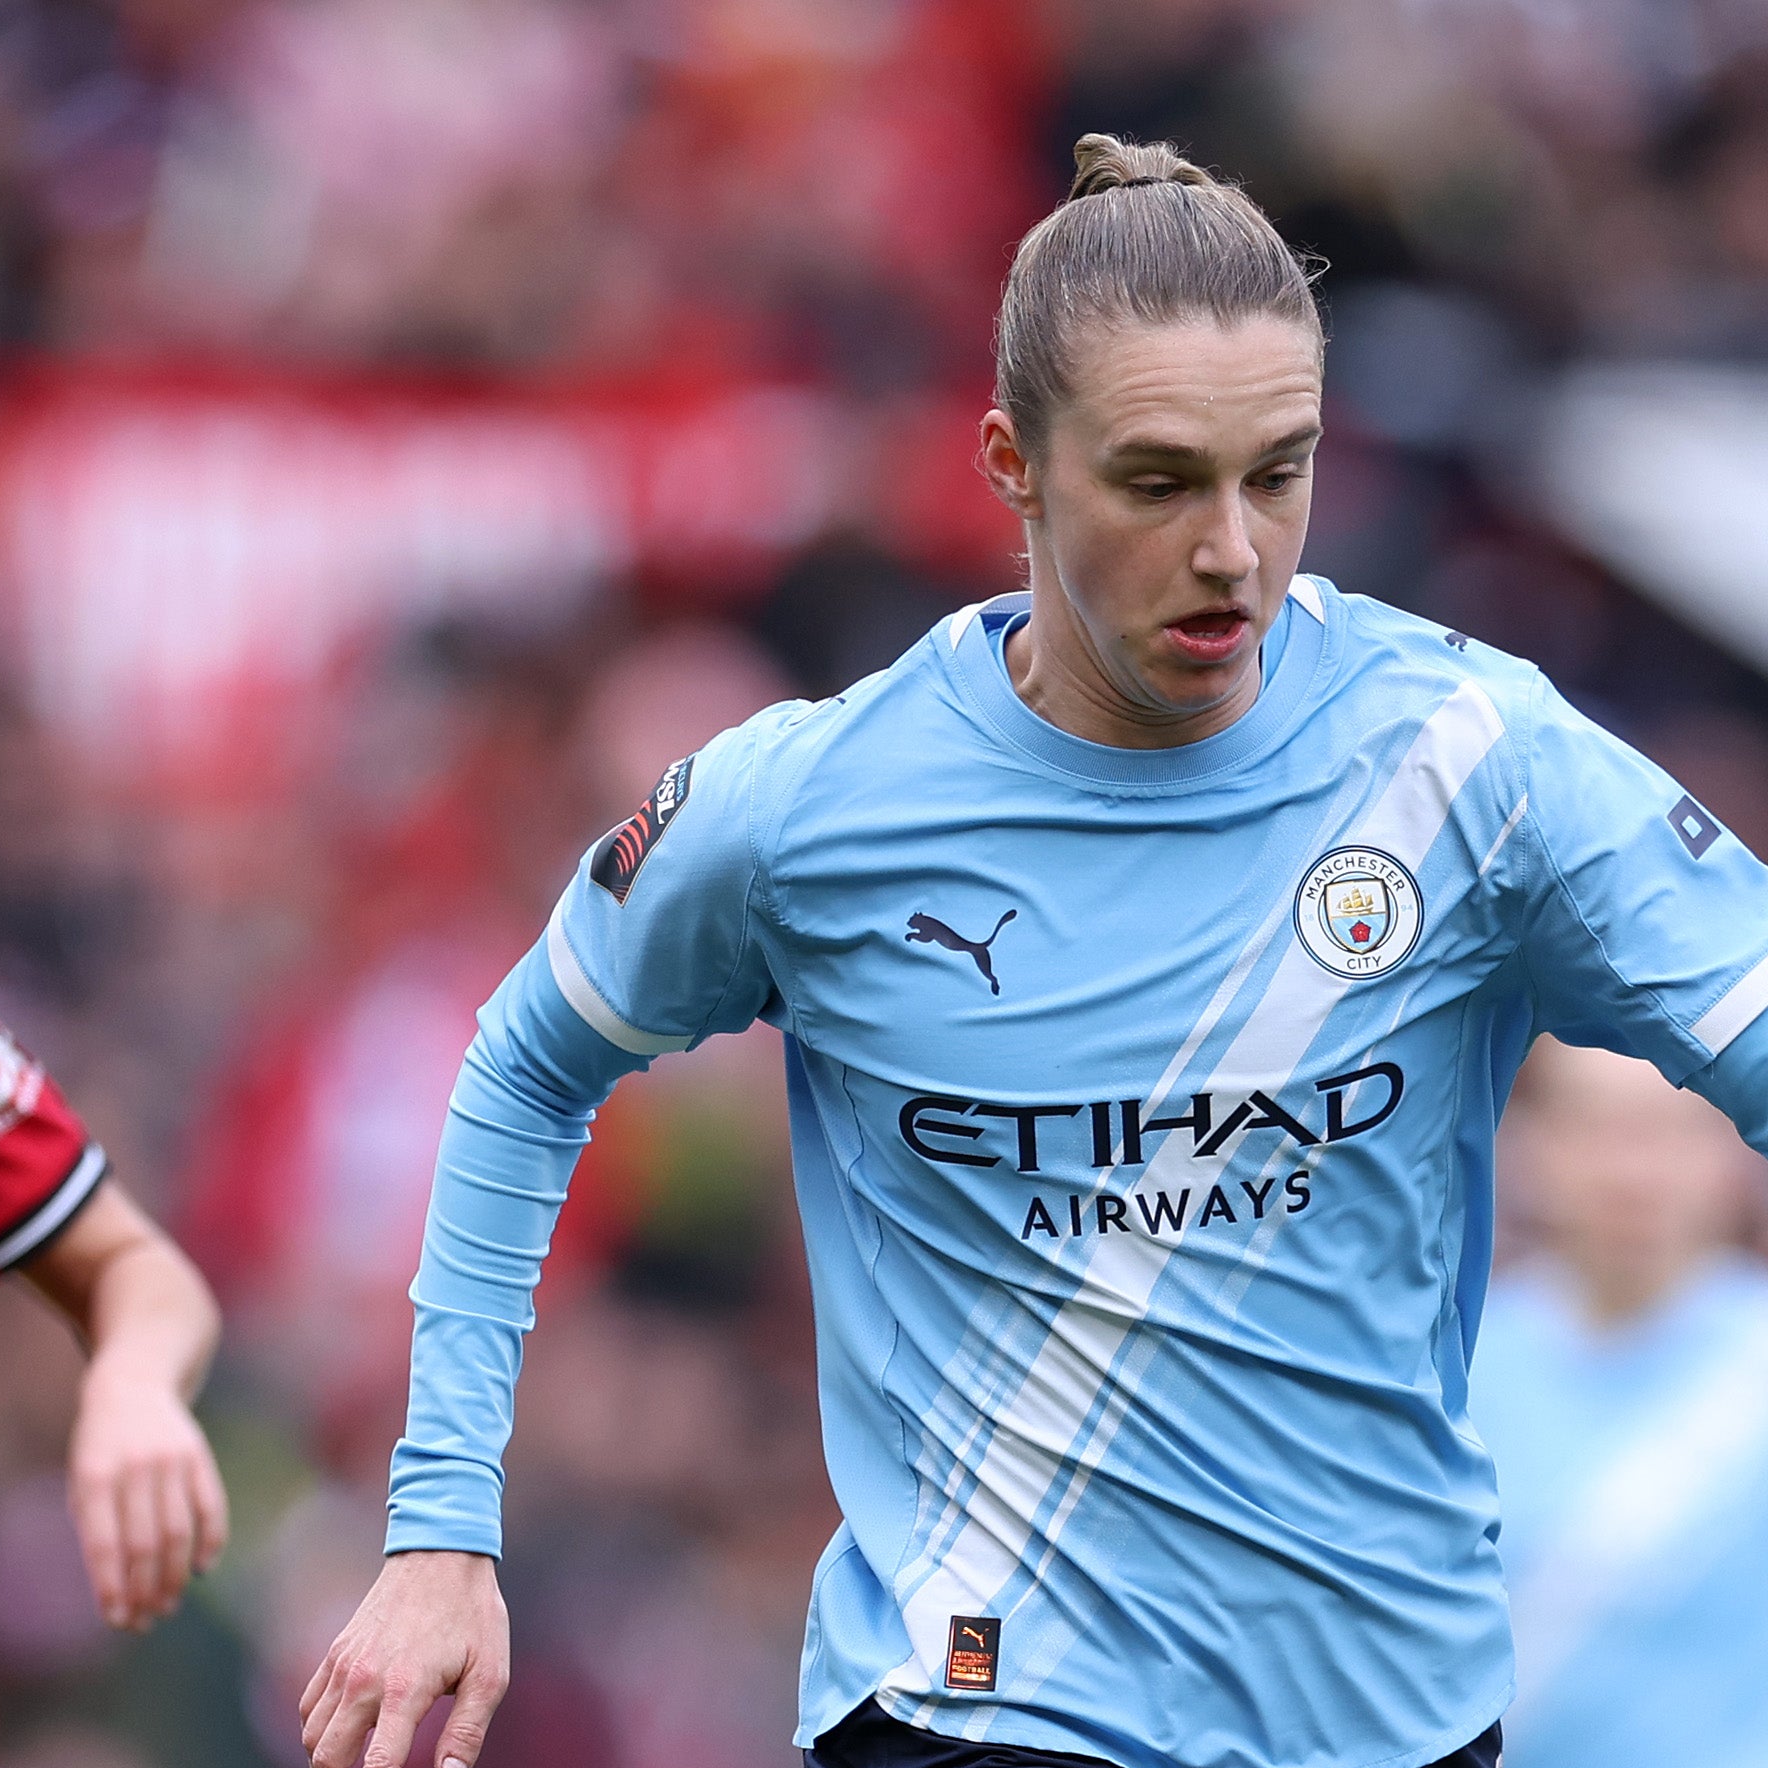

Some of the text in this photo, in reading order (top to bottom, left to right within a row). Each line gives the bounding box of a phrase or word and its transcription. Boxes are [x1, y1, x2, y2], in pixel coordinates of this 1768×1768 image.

[656, 757, 687, 825] WSL
[1306, 856, 1405, 900] MANCHESTER
[1346, 955, 1382, 970] CITY
[898, 1061, 1405, 1172] ETIHAD
[1020, 1170, 1312, 1240] AIRWAYS
